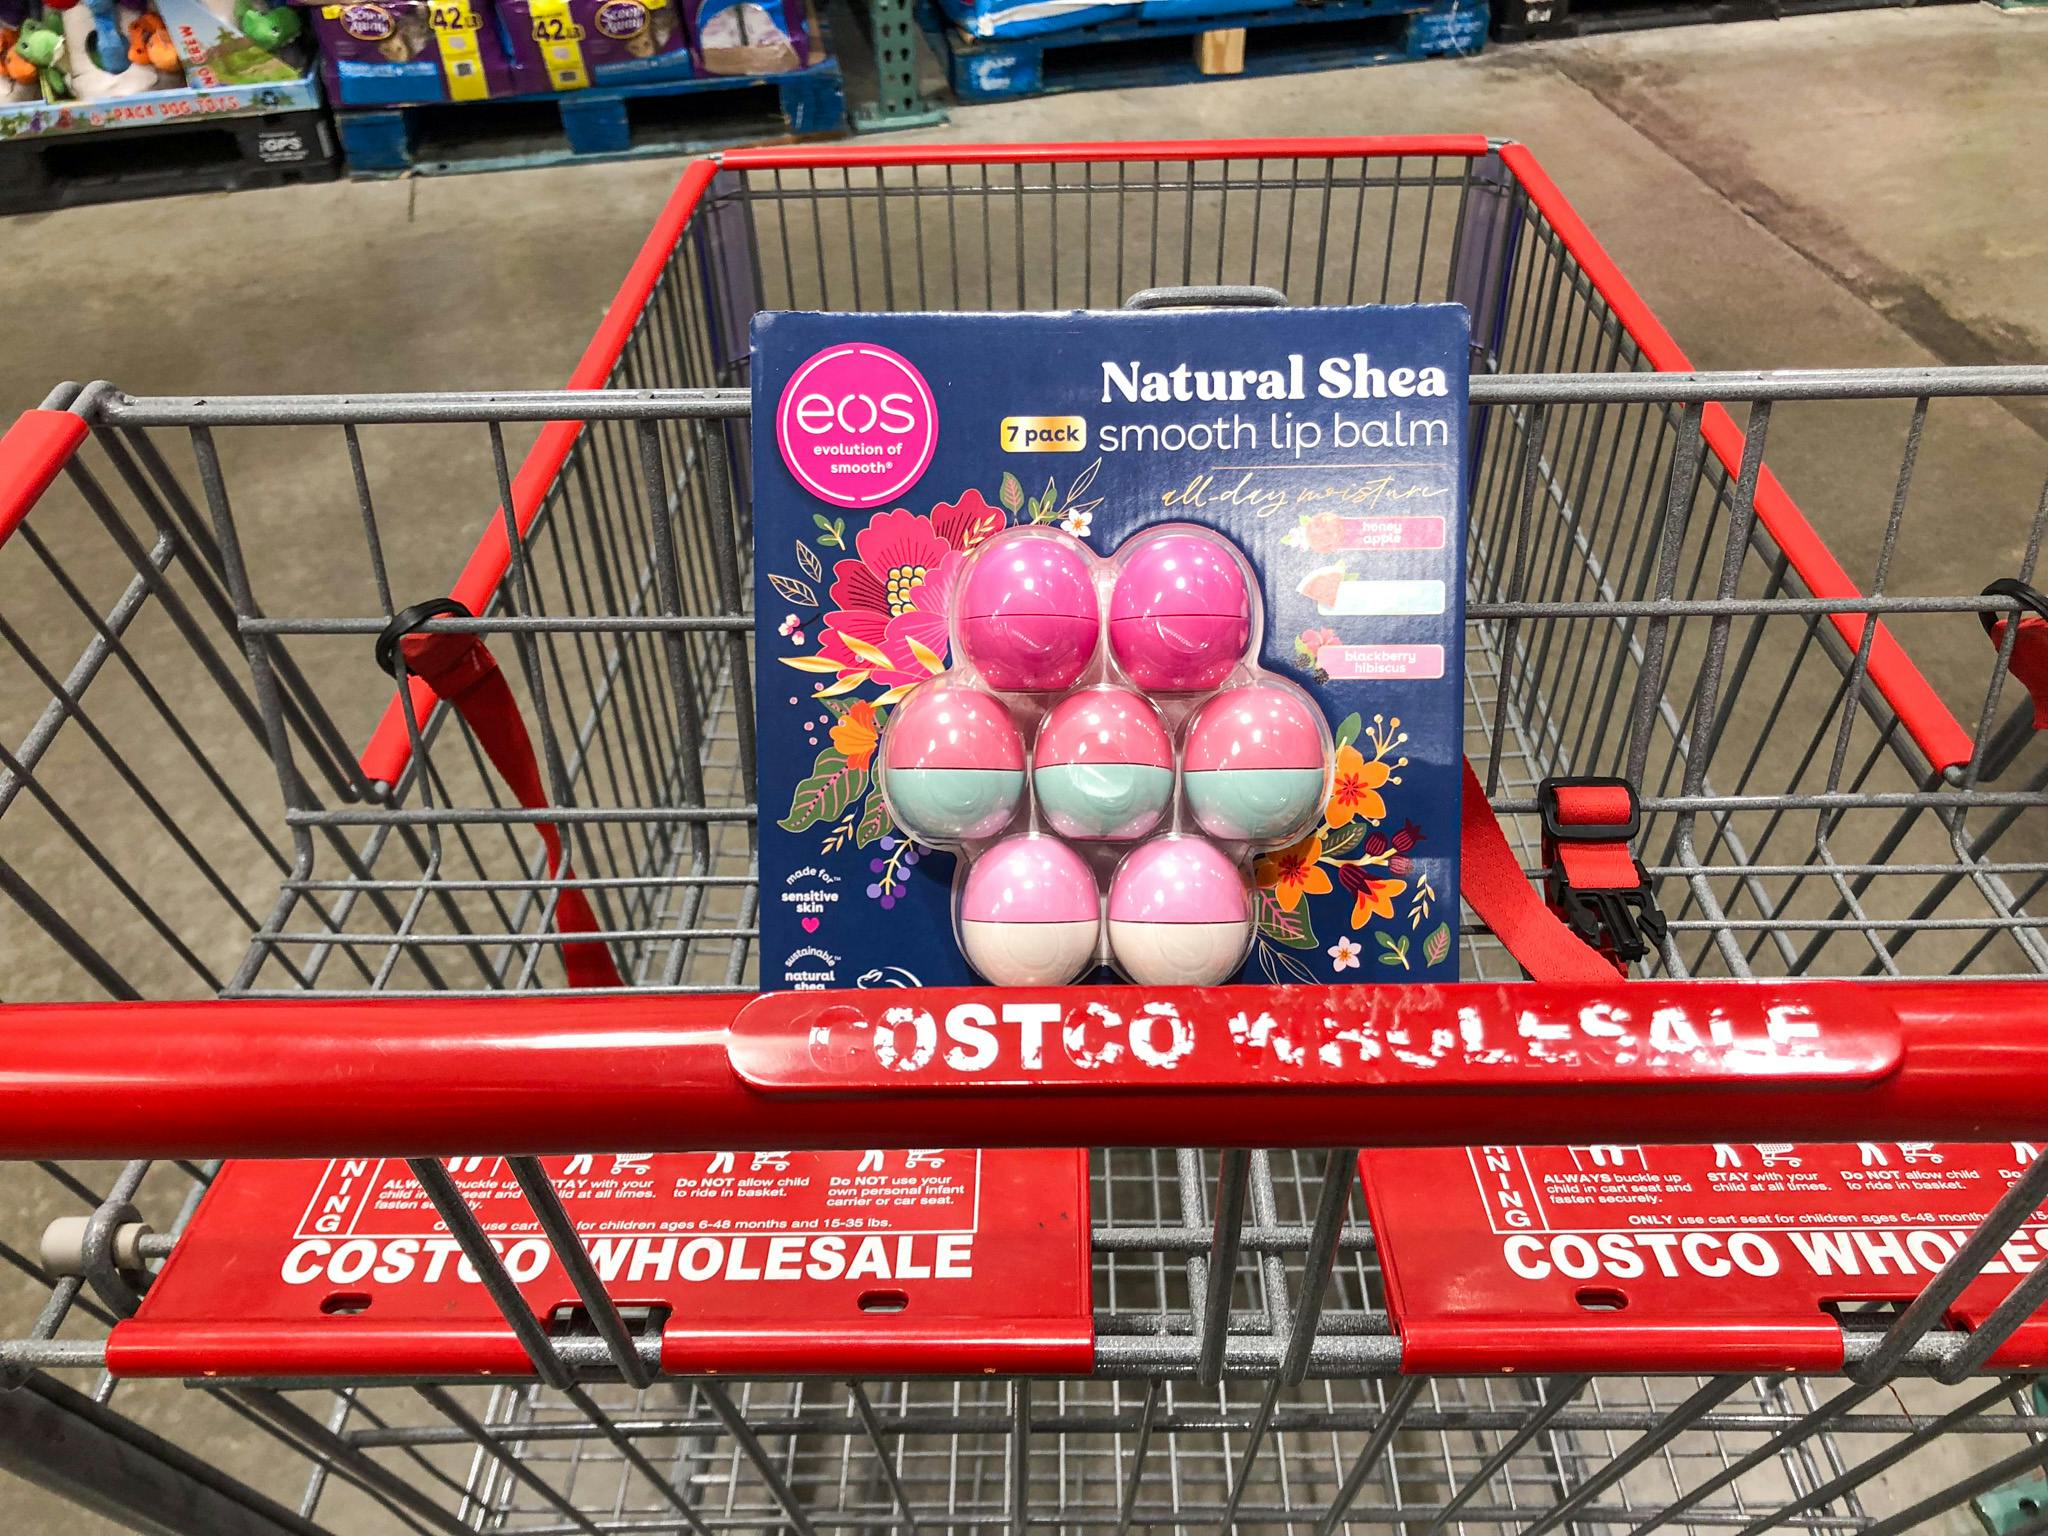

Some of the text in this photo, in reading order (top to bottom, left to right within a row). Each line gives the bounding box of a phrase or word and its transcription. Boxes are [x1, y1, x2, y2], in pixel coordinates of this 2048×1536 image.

[434, 7, 463, 30] 42
[537, 19, 565, 41] 42
[1101, 352, 1449, 403] Natural Shea
[796, 393, 915, 434] eos
[1006, 425, 1080, 447] 7 pack
[1099, 411, 1449, 459] smooth lip balm
[813, 443, 903, 455] evolution of
[1161, 473, 1449, 517] all-day moisture
[1362, 521, 1402, 534] honey
[1363, 533, 1402, 545] apple
[1345, 651, 1417, 664] blackberry
[1355, 663, 1407, 674] hibiscus
[786, 866, 817, 885] made
[781, 890, 839, 902] sensitive
[796, 901, 824, 913] skin
[785, 970, 836, 981] natural
[794, 982, 826, 990] shea
[1544, 1173, 1682, 1184] ALWAYS buckle up
[1707, 1172, 1818, 1183] STAY with your
[1840, 1170, 1980, 1180] Do NOT allow child
[1998, 1170, 2022, 1179] Do
[502, 1181, 519, 1191] up
[591, 1179, 618, 1189] with
[622, 1180, 654, 1192] your
[676, 1177, 810, 1188] Do NOT allow child
[830, 1176, 952, 1187] Do NOT use your
[1712, 1182, 1832, 1192] child at all times.
[1847, 1180, 1967, 1190] to ride in basket.
[379, 1189, 413, 1199] child
[461, 1190, 492, 1199] seat
[494, 1189, 522, 1199] and
[577, 1190, 592, 1199] at
[595, 1188, 611, 1199] all
[615, 1188, 656, 1199] times.
[673, 1187, 787, 1198] to ride in basket.
[828, 1185, 964, 1197] own personal infant
[1547, 1183, 1693, 1194] child in cart seat and
[374, 1200, 418, 1209] fasten
[827, 1195, 954, 1207] carrier or car seat.
[1550, 1194, 1663, 1205] fasten securely.
[576, 1217, 892, 1232] for children ages 6-48 months and 15-35 lbs.
[1628, 1215, 1672, 1225] ONLY
[1678, 1216, 1704, 1224] use
[1708, 1215, 1737, 1224] cart
[1740, 1214, 1773, 1224] seat
[1774, 1214, 1795, 1223] for
[1799, 1213, 1858, 1223] children
[1862, 1214, 1898, 1225] ages
[1902, 1212, 1935, 1222] 6-48
[482, 1221, 539, 1231] use cart
[581, 1235, 974, 1281] WHOLESALE
[1503, 1233, 1780, 1279] COSTCO
